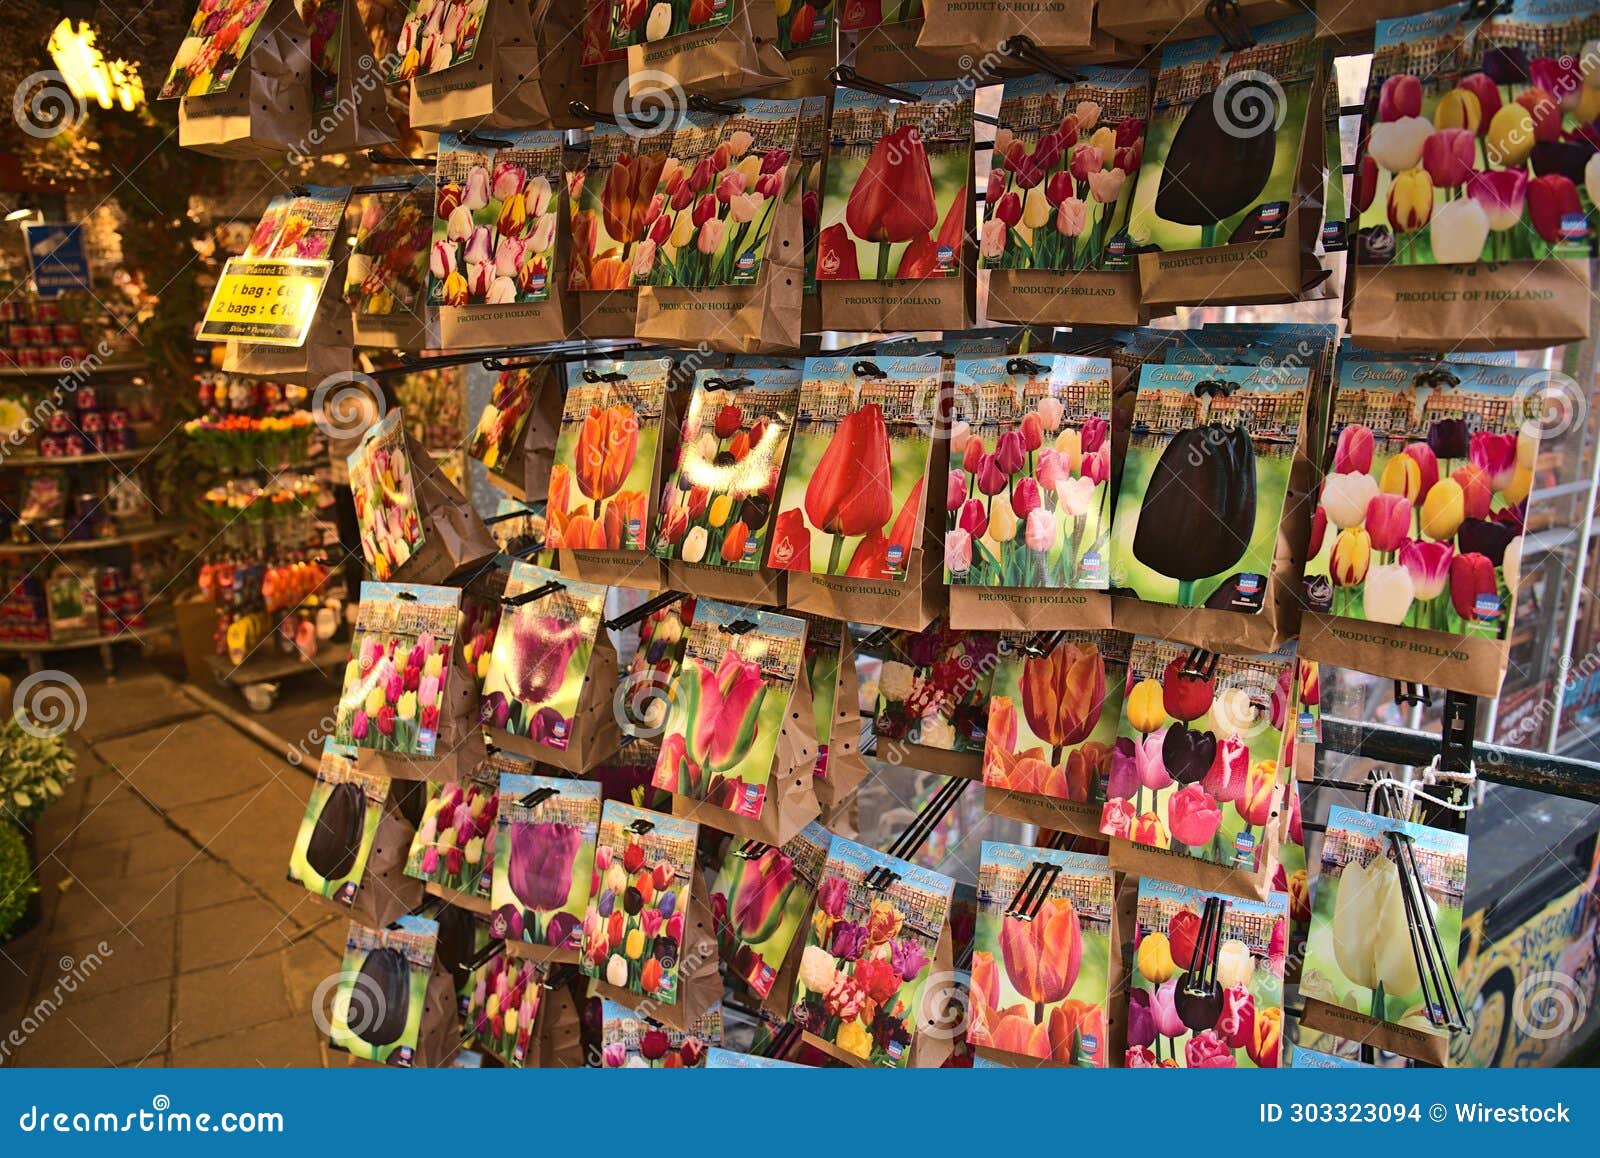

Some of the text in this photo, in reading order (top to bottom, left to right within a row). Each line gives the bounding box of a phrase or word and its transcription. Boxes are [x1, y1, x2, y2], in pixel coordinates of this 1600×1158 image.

[947, 1, 1065, 12] PRODUCT OF HOLLAND
[1159, 250, 1268, 270] PRODUCT OF HOLLAND
[232, 283, 238, 294] 1
[241, 284, 264, 298] bag
[1012, 286, 1116, 297] PRODUCT OF HOLLAND
[1395, 289, 1555, 303] PRODUCT OF HOLLAND
[658, 302, 745, 311] PRODUCT OF HOLLAND
[845, 296, 941, 305] PRODUCT OF HOLLAND
[216, 302, 225, 313] 2
[228, 302, 256, 317] bags
[457, 309, 541, 323] PRODUCT OF HOLLAND
[884, 359, 937, 373] Amsterdam
[1240, 369, 1305, 386] Amsterdam
[811, 576, 902, 598] PRODUCT OF HOLLAND
[978, 593, 1087, 605] PRODUCT OF HOLLAND
[1331, 628, 1470, 661] PRODUCT OF HOLLAND
